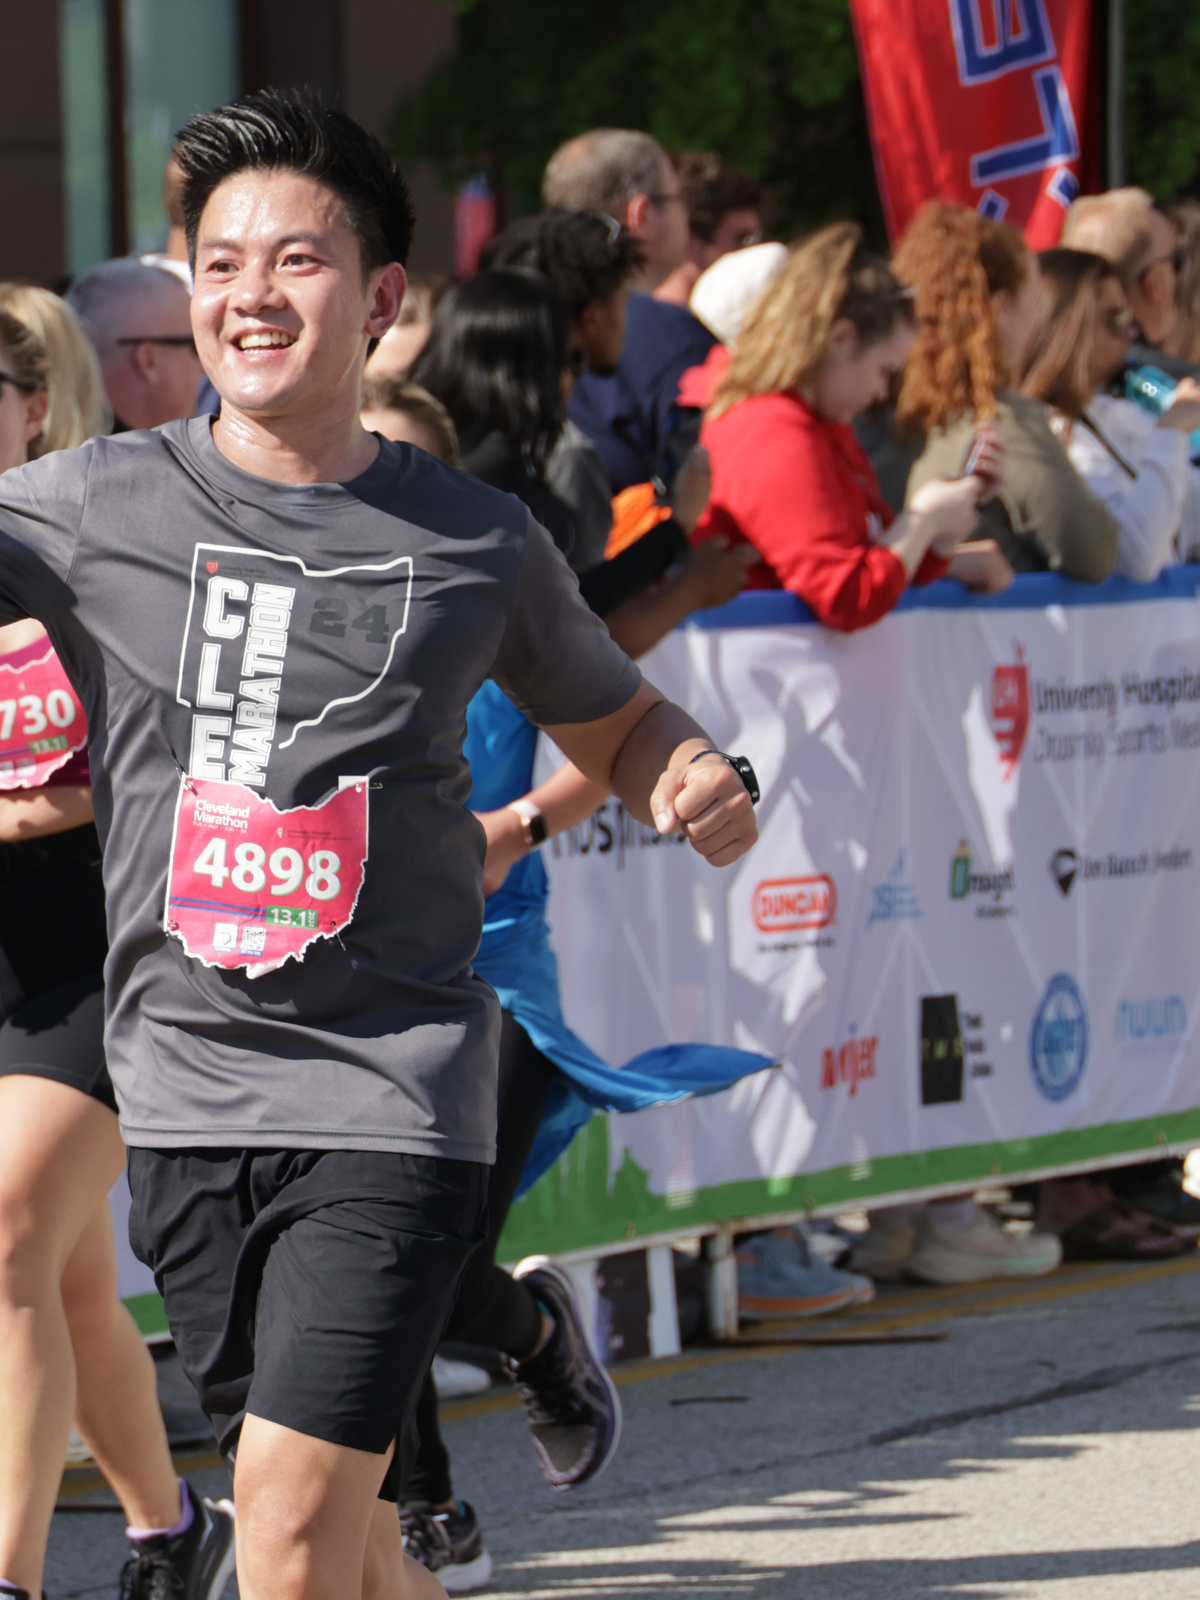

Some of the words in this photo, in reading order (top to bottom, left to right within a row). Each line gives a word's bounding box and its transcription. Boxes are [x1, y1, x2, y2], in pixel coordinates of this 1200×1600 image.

[308, 596, 390, 645] 24
[227, 582, 296, 788] MARATHON
[193, 810, 249, 829] Marathon
[194, 799, 251, 819] Cleveland
[193, 837, 341, 900] 4898
[270, 907, 307, 927] 13.1
